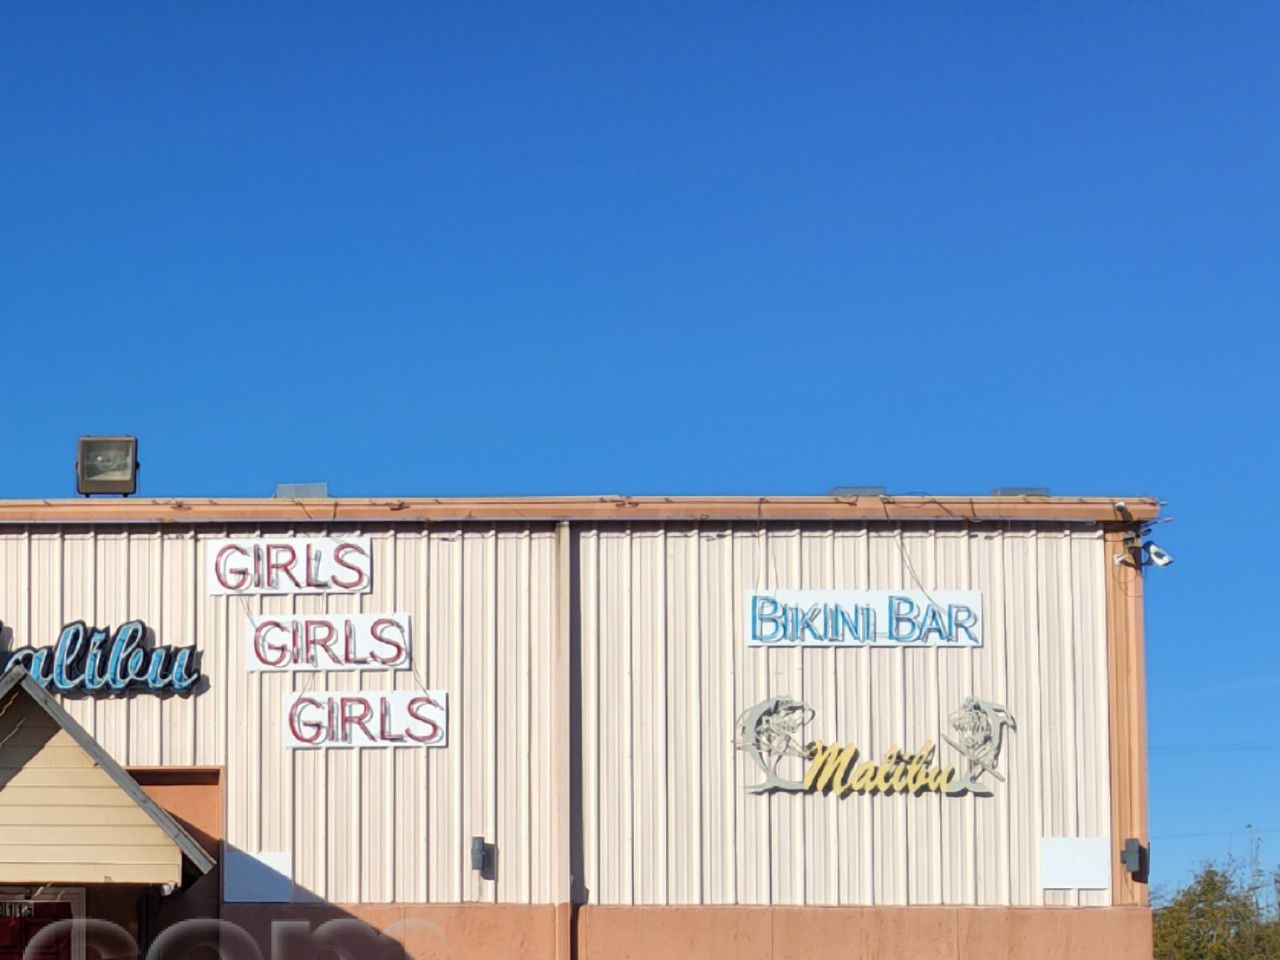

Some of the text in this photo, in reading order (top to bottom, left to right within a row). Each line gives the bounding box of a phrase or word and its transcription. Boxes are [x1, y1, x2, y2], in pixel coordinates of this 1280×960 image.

[215, 542, 370, 591] GIRLS
[253, 618, 409, 668] GIRLS
[288, 696, 445, 745] GIRLS
[803, 740, 957, 797] Malibu
